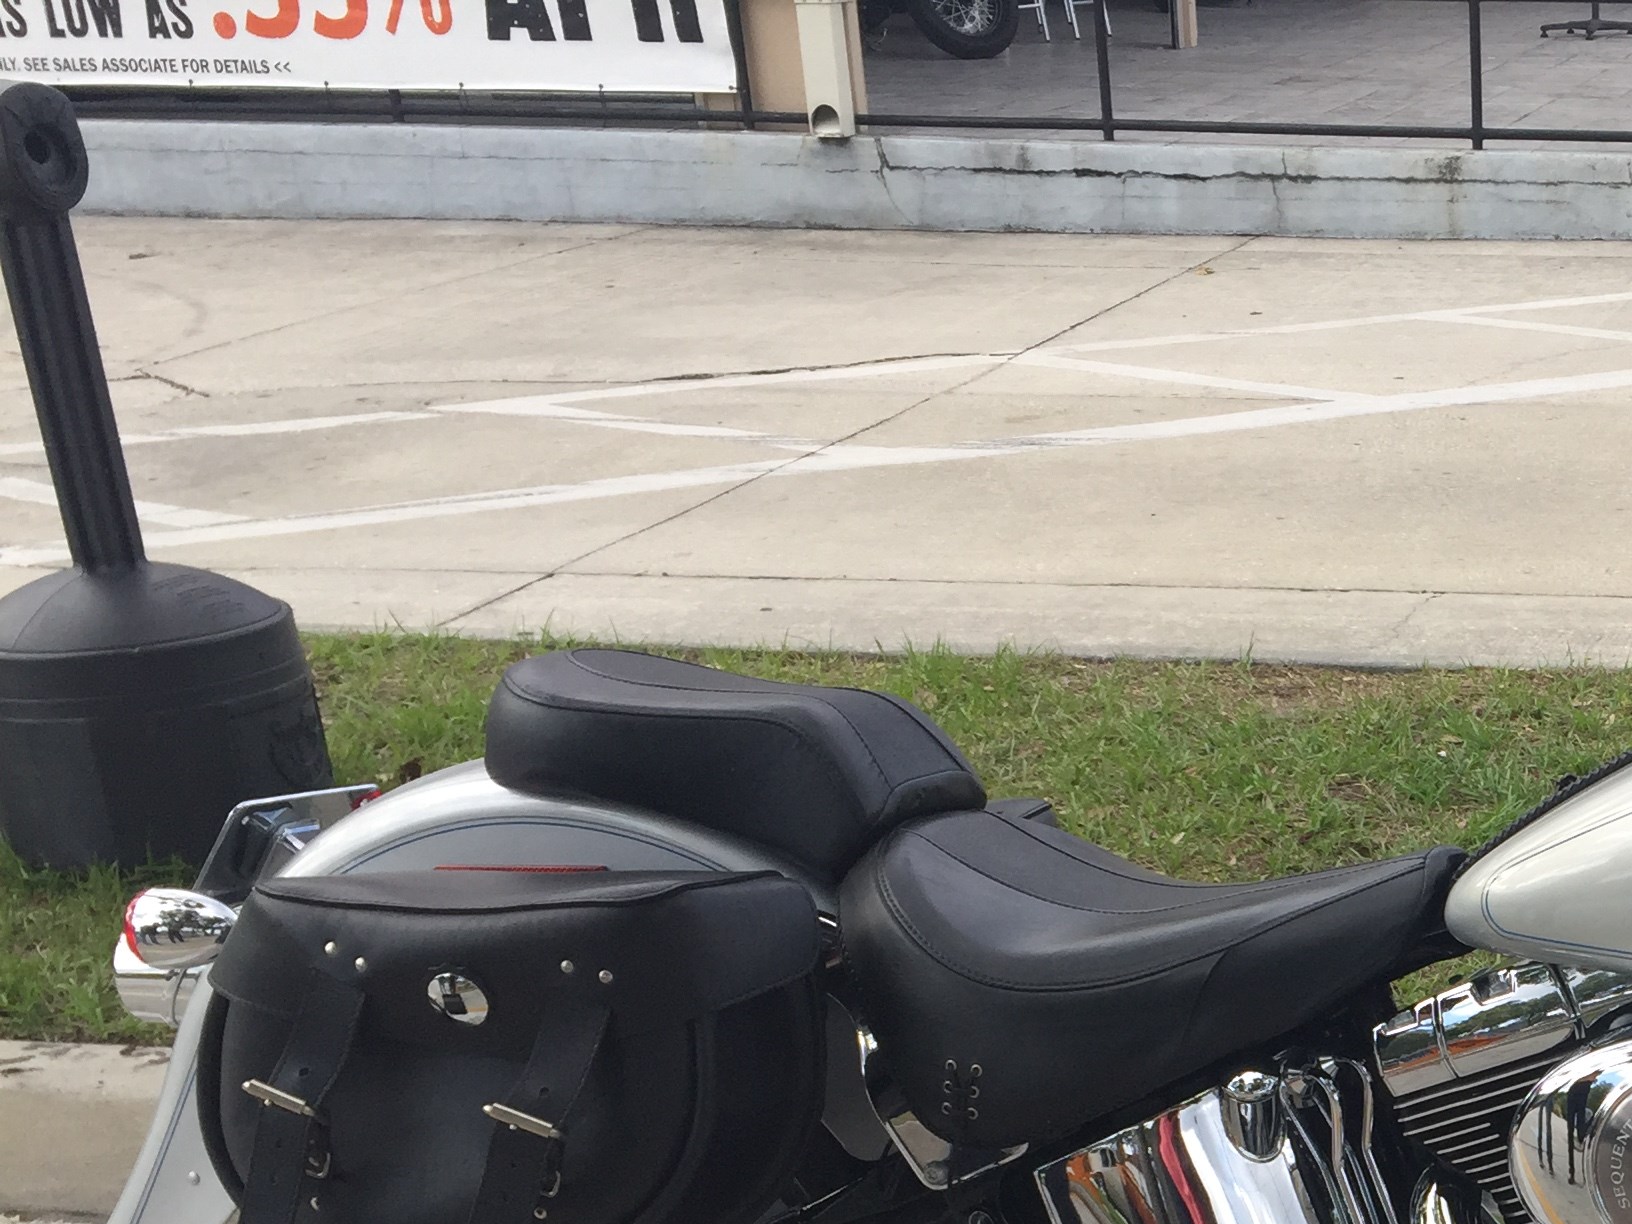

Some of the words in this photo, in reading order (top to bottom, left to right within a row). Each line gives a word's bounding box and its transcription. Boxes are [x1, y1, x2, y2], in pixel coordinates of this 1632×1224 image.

[0, 0, 27, 38] S
[145, 0, 194, 39] AS
[23, 57, 50, 72] SEE
[53, 57, 98, 72] SALES
[102, 57, 179, 73] ASSOCIATE
[182, 59, 210, 74] FOR
[214, 59, 270, 74] DETAILS
